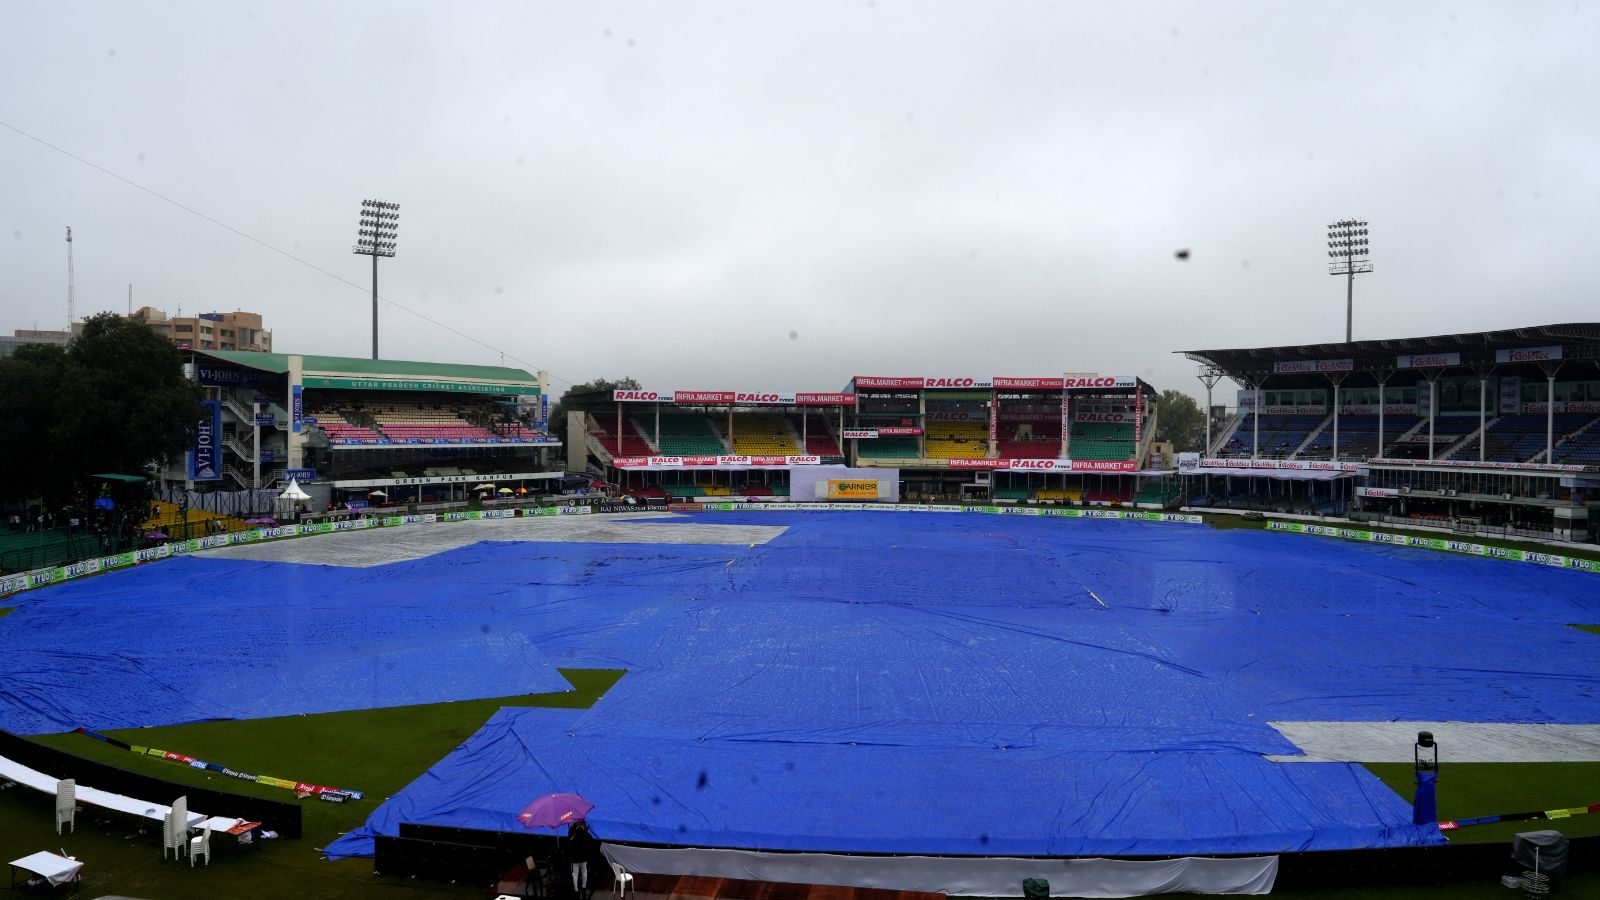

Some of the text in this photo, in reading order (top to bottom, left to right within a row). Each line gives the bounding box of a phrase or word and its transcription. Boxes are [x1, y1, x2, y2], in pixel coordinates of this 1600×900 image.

[925, 378, 973, 387] RALCO
[1065, 378, 1115, 388] RALCO
[615, 391, 658, 400] RALCO
[737, 393, 778, 402] RALCO
[926, 412, 968, 420] RALCO
[1077, 413, 1123, 422] RALCO
[1010, 460, 1054, 469] RALCO
[839, 483, 877, 491] GARNIER
